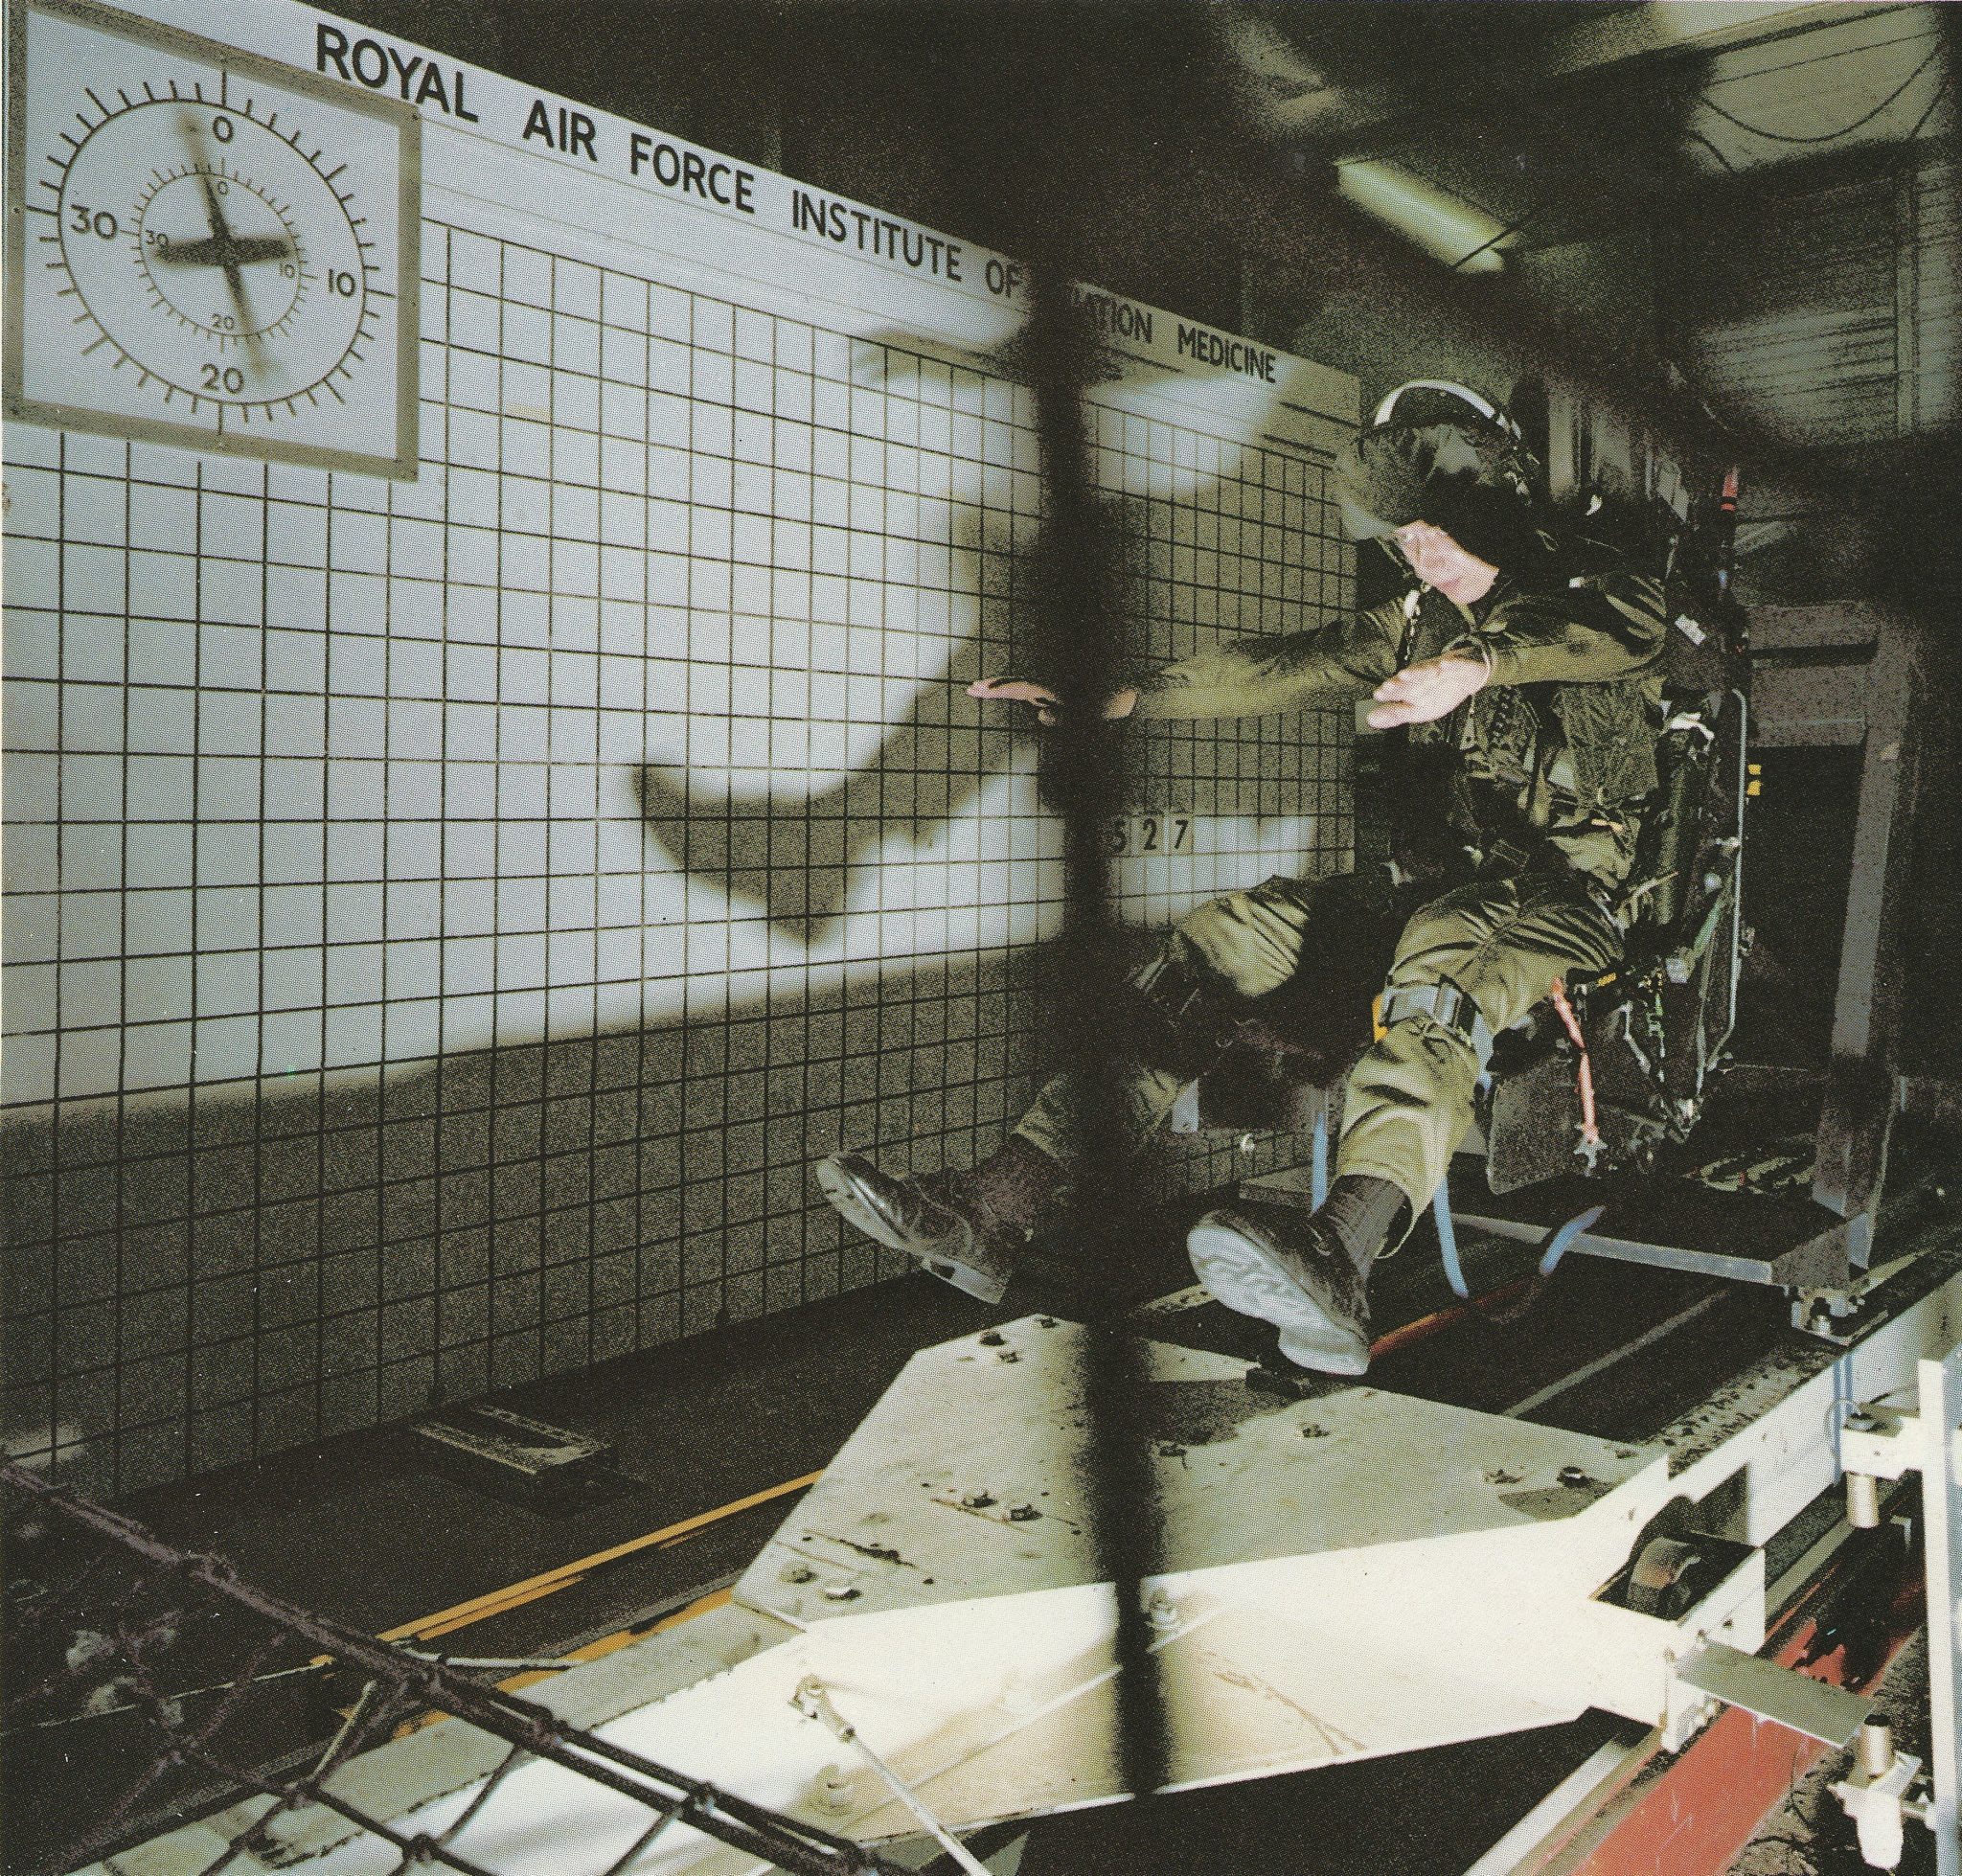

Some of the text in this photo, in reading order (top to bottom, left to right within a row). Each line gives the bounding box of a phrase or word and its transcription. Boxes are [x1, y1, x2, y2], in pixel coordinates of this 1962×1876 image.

[213, 115, 234, 143] 0
[217, 180, 229, 195] 0
[316, 23, 479, 124] ROYAL
[523, 99, 599, 162] AIR
[629, 132, 755, 215] FORCE
[792, 190, 962, 283] INSTITUTE
[985, 259, 1023, 297] OF
[1177, 323, 1277, 383] MEDICINE
[71, 204, 118, 240] 30
[146, 230, 168, 247] 30
[279, 263, 296, 279] 10
[328, 268, 355, 298] 10
[212, 313, 235, 330] 20
[201, 363, 244, 394] 20
